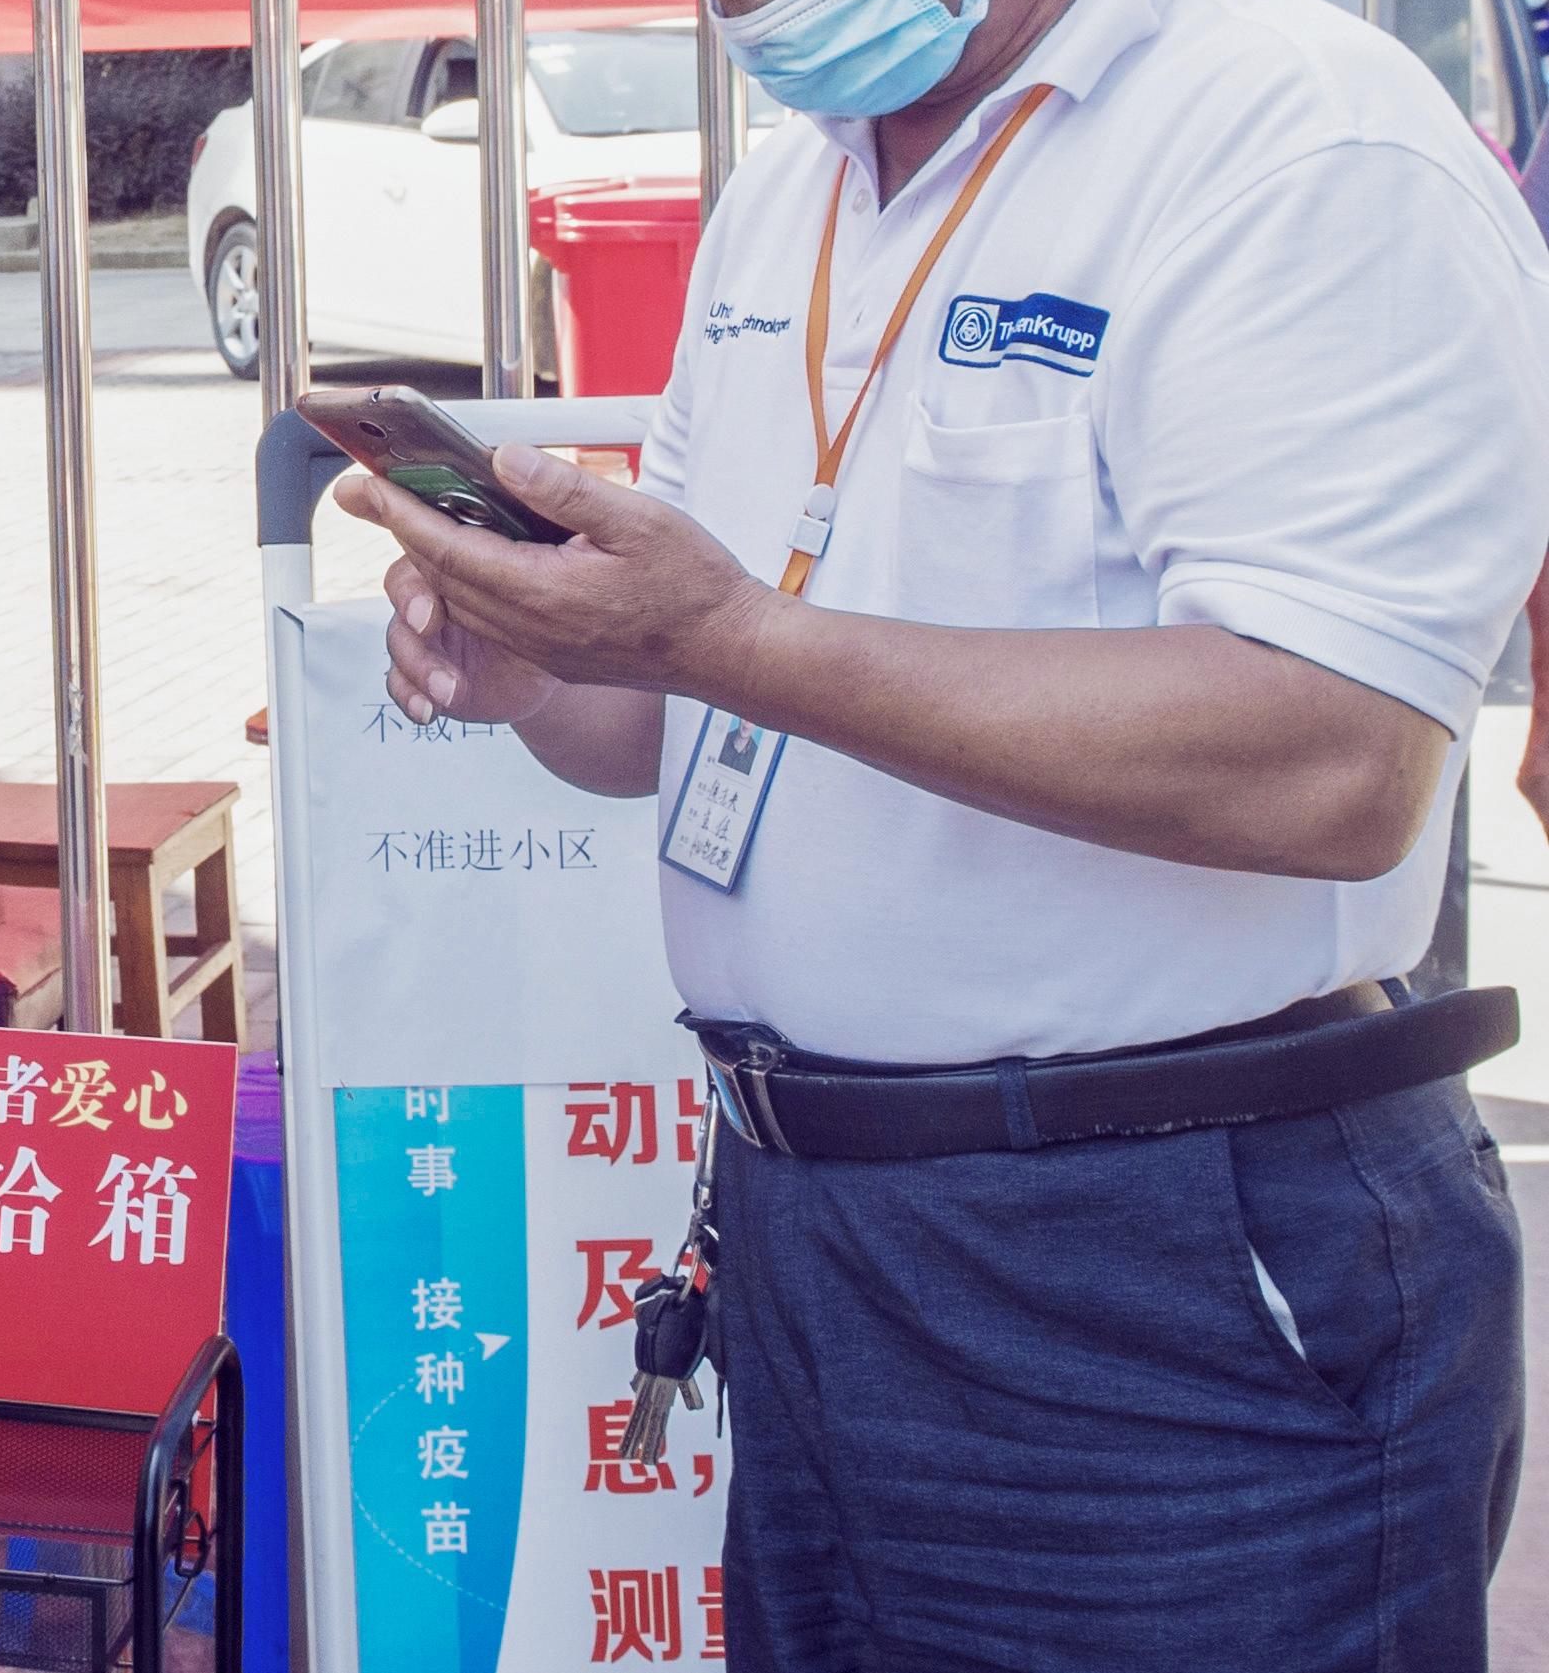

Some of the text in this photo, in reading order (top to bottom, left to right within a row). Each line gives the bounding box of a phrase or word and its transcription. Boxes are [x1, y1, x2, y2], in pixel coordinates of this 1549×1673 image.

[366, 827, 598, 873] 不准进小区
[411, 1277, 471, 1555] 接种疫苗
